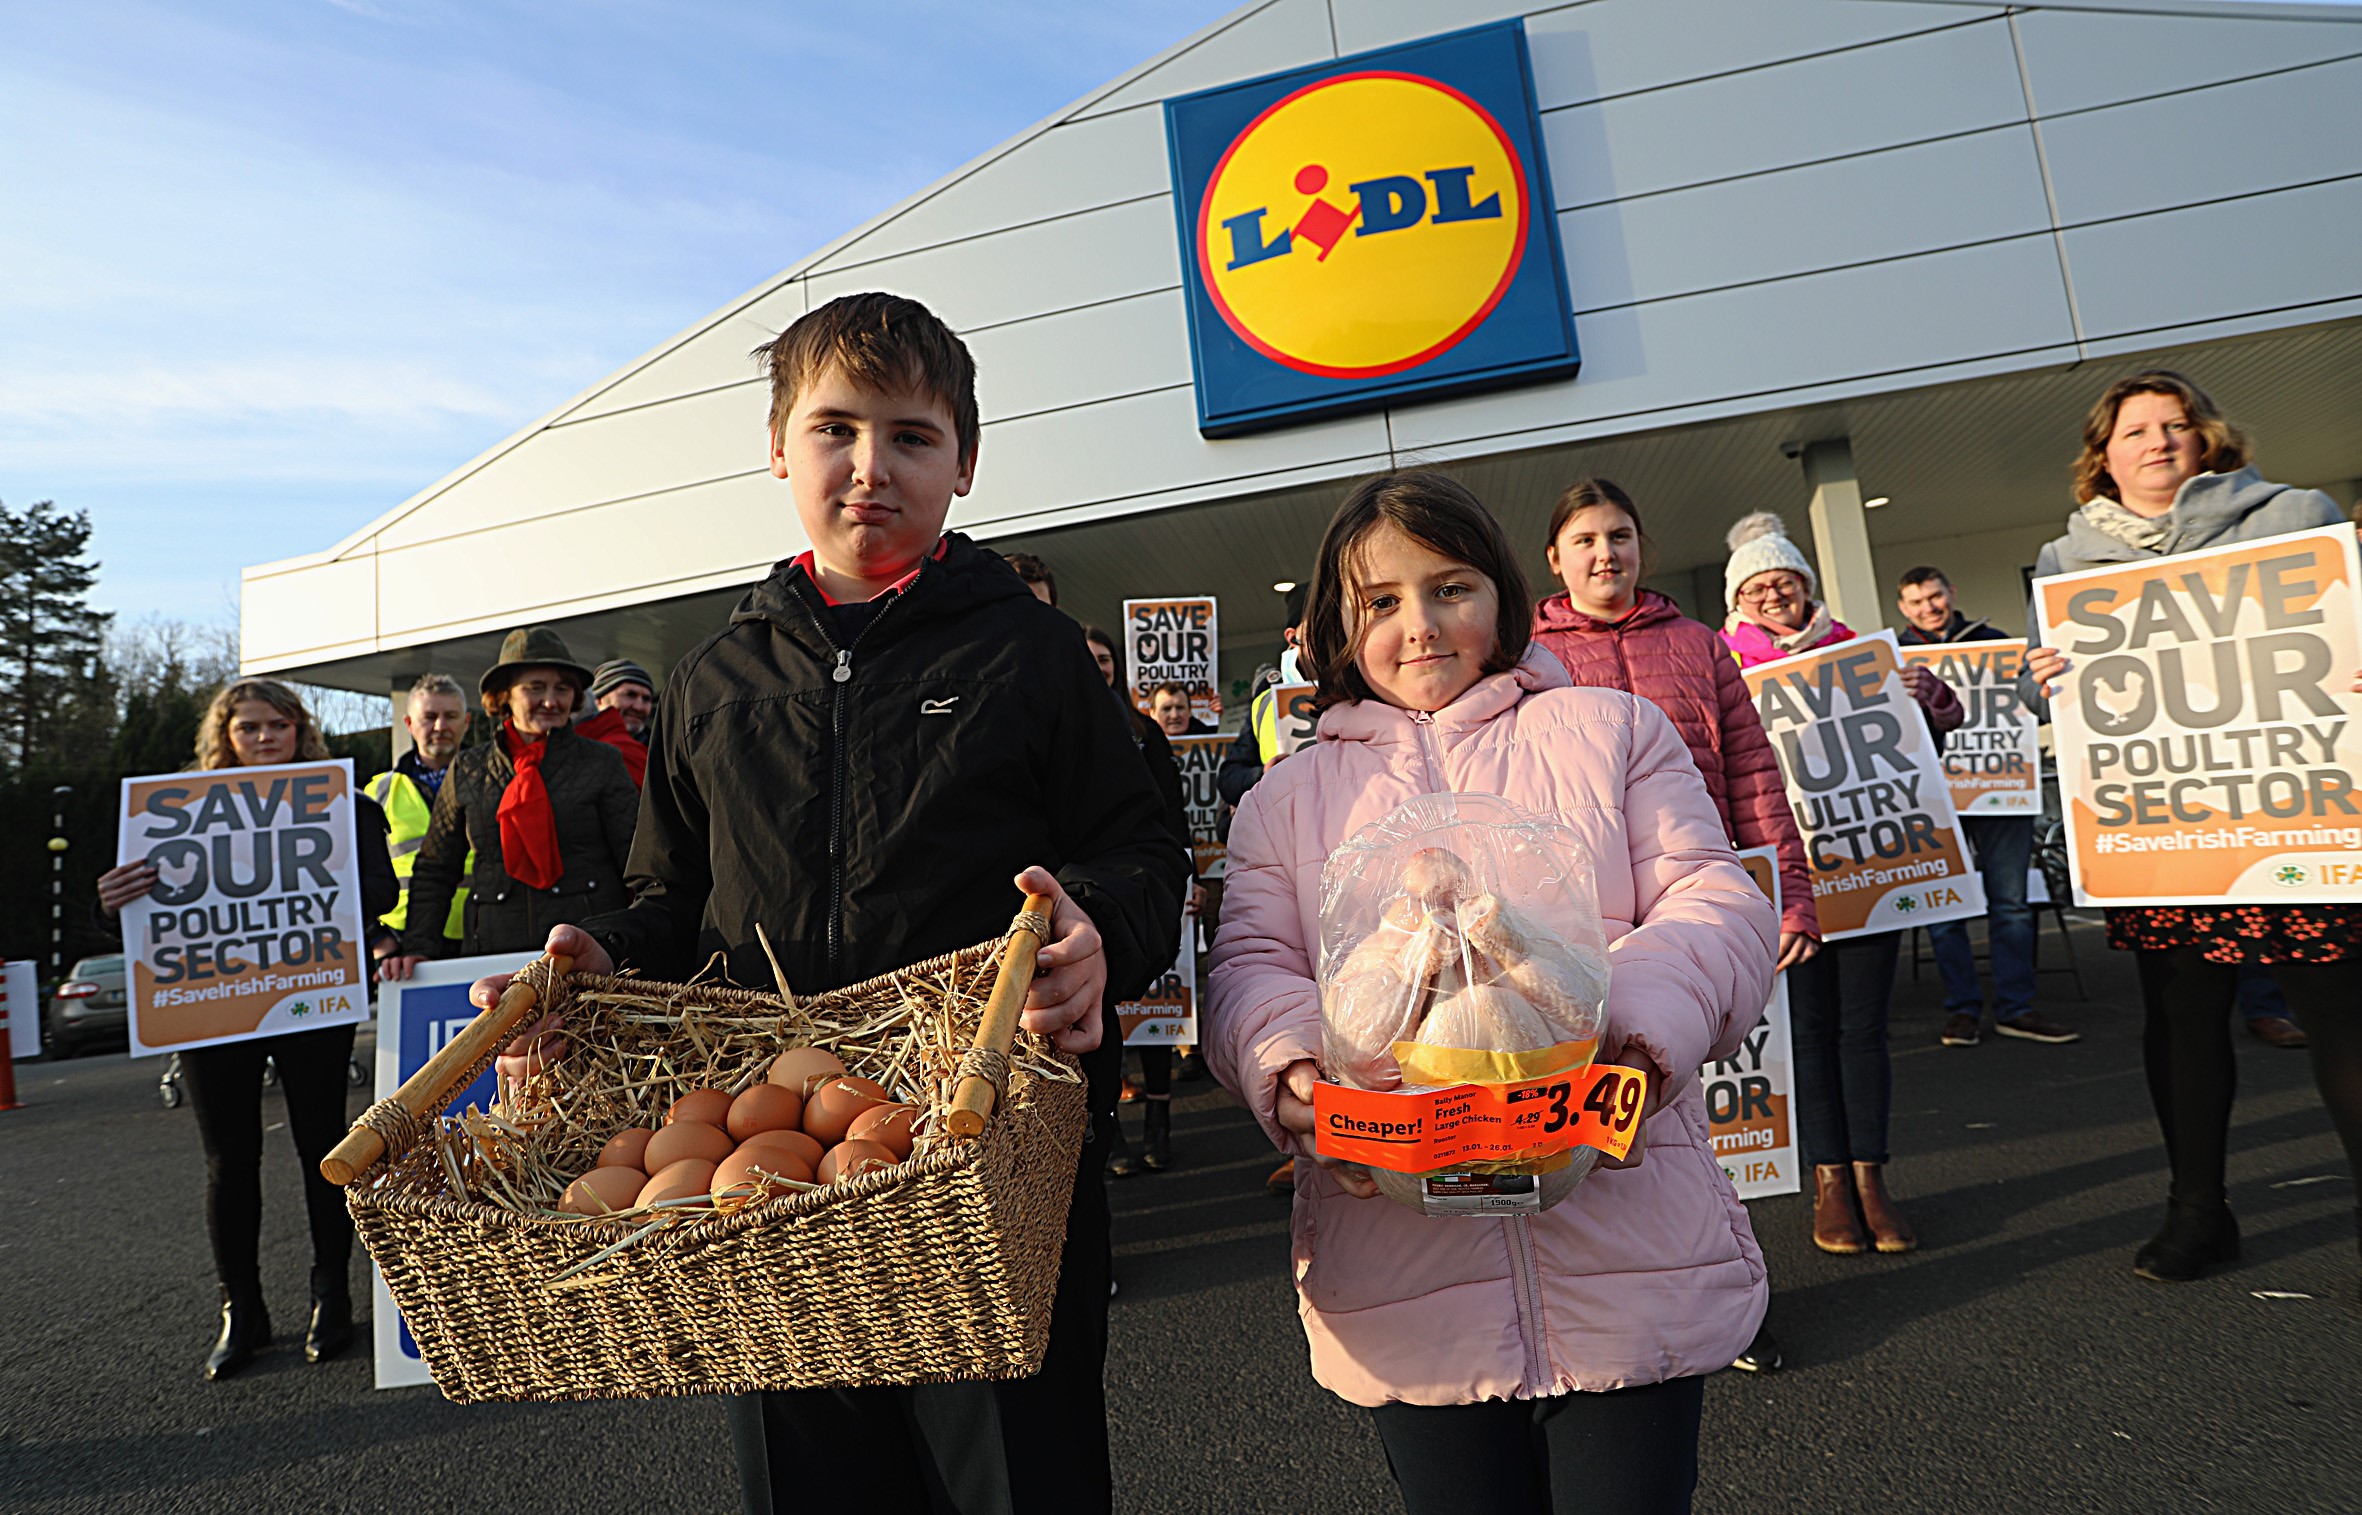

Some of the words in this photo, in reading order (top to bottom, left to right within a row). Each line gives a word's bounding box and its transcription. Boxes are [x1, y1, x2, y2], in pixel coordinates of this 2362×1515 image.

[1135, 605, 1207, 632] SAVE
[2067, 551, 2325, 655] SAVE
[1137, 632, 1208, 664] OUR
[1138, 664, 1209, 680] POULTRY
[2079, 632, 2348, 737] OUR
[1760, 651, 1890, 732] AVE
[1779, 710, 1918, 793] UR
[1945, 730, 2023, 751] ULTRY
[2088, 720, 2348, 780] POULTRY
[1945, 752, 2024, 776] CTOR
[144, 774, 331, 838] SAVE
[1794, 774, 1920, 831] ULTRY
[2007, 797, 2029, 807] IFA
[2095, 768, 2361, 827] SECTOR
[1809, 813, 1944, 872] CTOR
[2095, 823, 2362, 854] #SaveIrishFarming
[146, 827, 338, 906] OUR
[1924, 888, 1963, 909] IFA
[150, 891, 340, 944] POULTRY
[153, 926, 344, 984] SECTOR
[152, 967, 345, 1009] #SaveIrishFarming
[319, 995, 351, 1014] IFA
[1165, 1024, 1186, 1036] IFA
[1435, 1097, 1452, 1105] Bally
[1453, 1091, 1477, 1102] Manor
[1517, 1088, 1539, 1099] -18%
[1544, 1072, 1641, 1133] 3.49
[1329, 1113, 1422, 1138] Cheaper!
[1434, 1120, 1460, 1131] Large
[1461, 1114, 1502, 1124] Chicken
[1435, 1102, 1470, 1120] Fresh
[1514, 1111, 1541, 1125] 4.29
[1745, 1161, 1779, 1182] IFA
